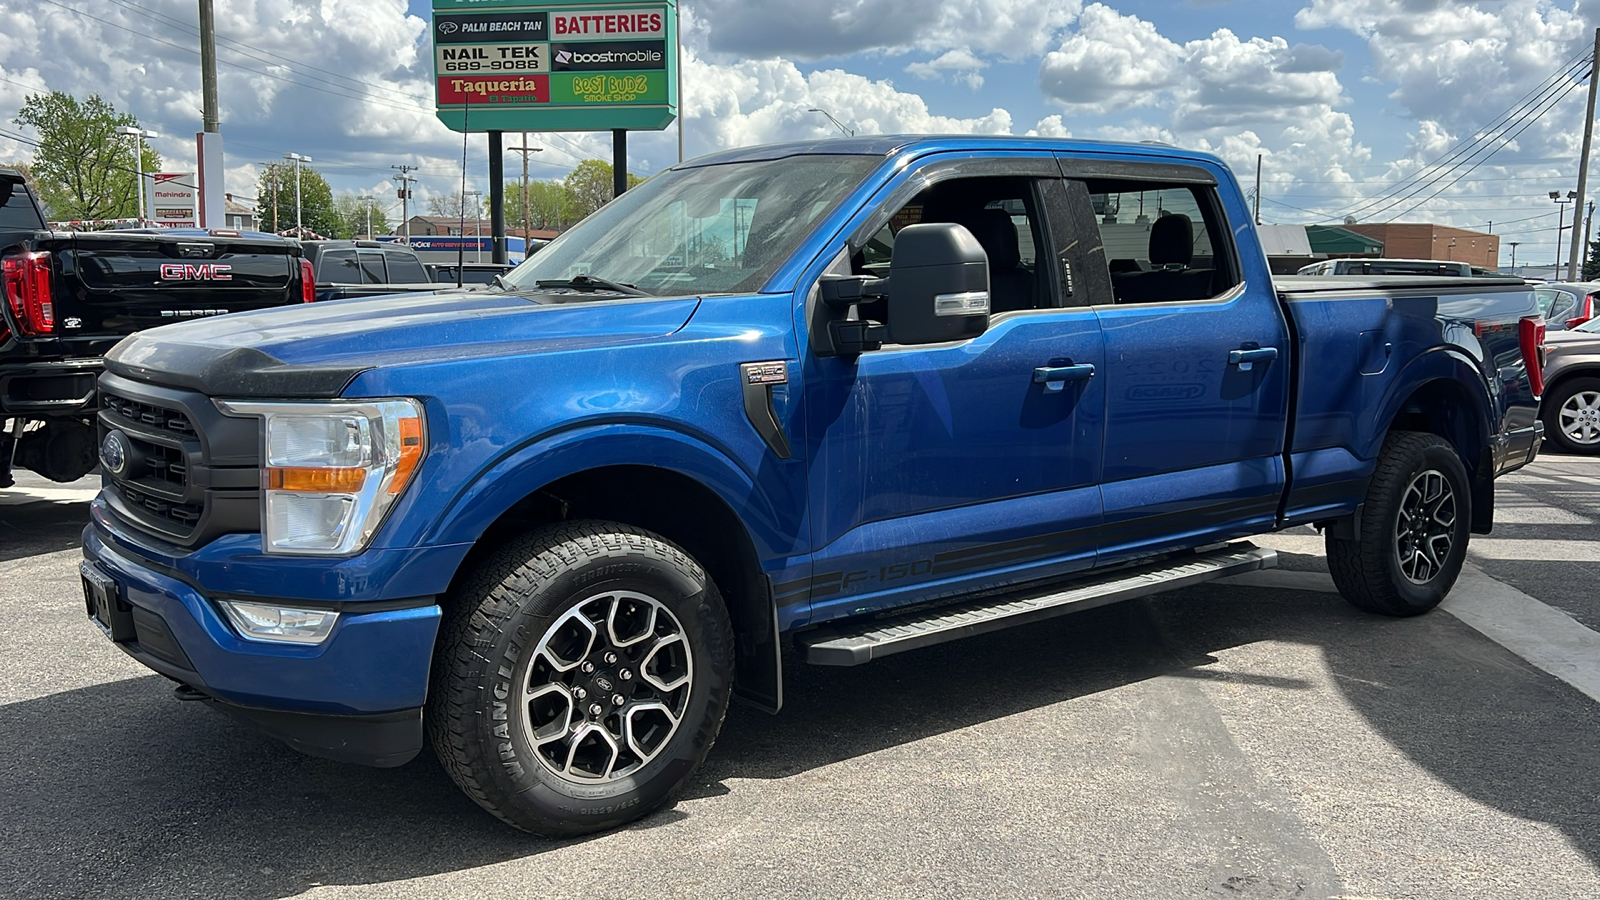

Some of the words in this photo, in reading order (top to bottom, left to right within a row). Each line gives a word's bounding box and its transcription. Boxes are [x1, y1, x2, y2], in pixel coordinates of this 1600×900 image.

[461, 22, 489, 33] PALM
[489, 21, 522, 32] BEACH
[523, 20, 542, 31] TAN
[555, 13, 662, 35] BATTERIES
[443, 47, 489, 60] NAIL
[497, 46, 539, 59] TEK
[573, 50, 661, 63] boostmobile
[445, 60, 539, 71] 689-9088
[584, 94, 612, 102] SMOKE
[613, 93, 636, 102] SHOP
[160, 263, 233, 280] GMC
[842, 559, 933, 590] F-150
[492, 624, 531, 781] WRANGLER
